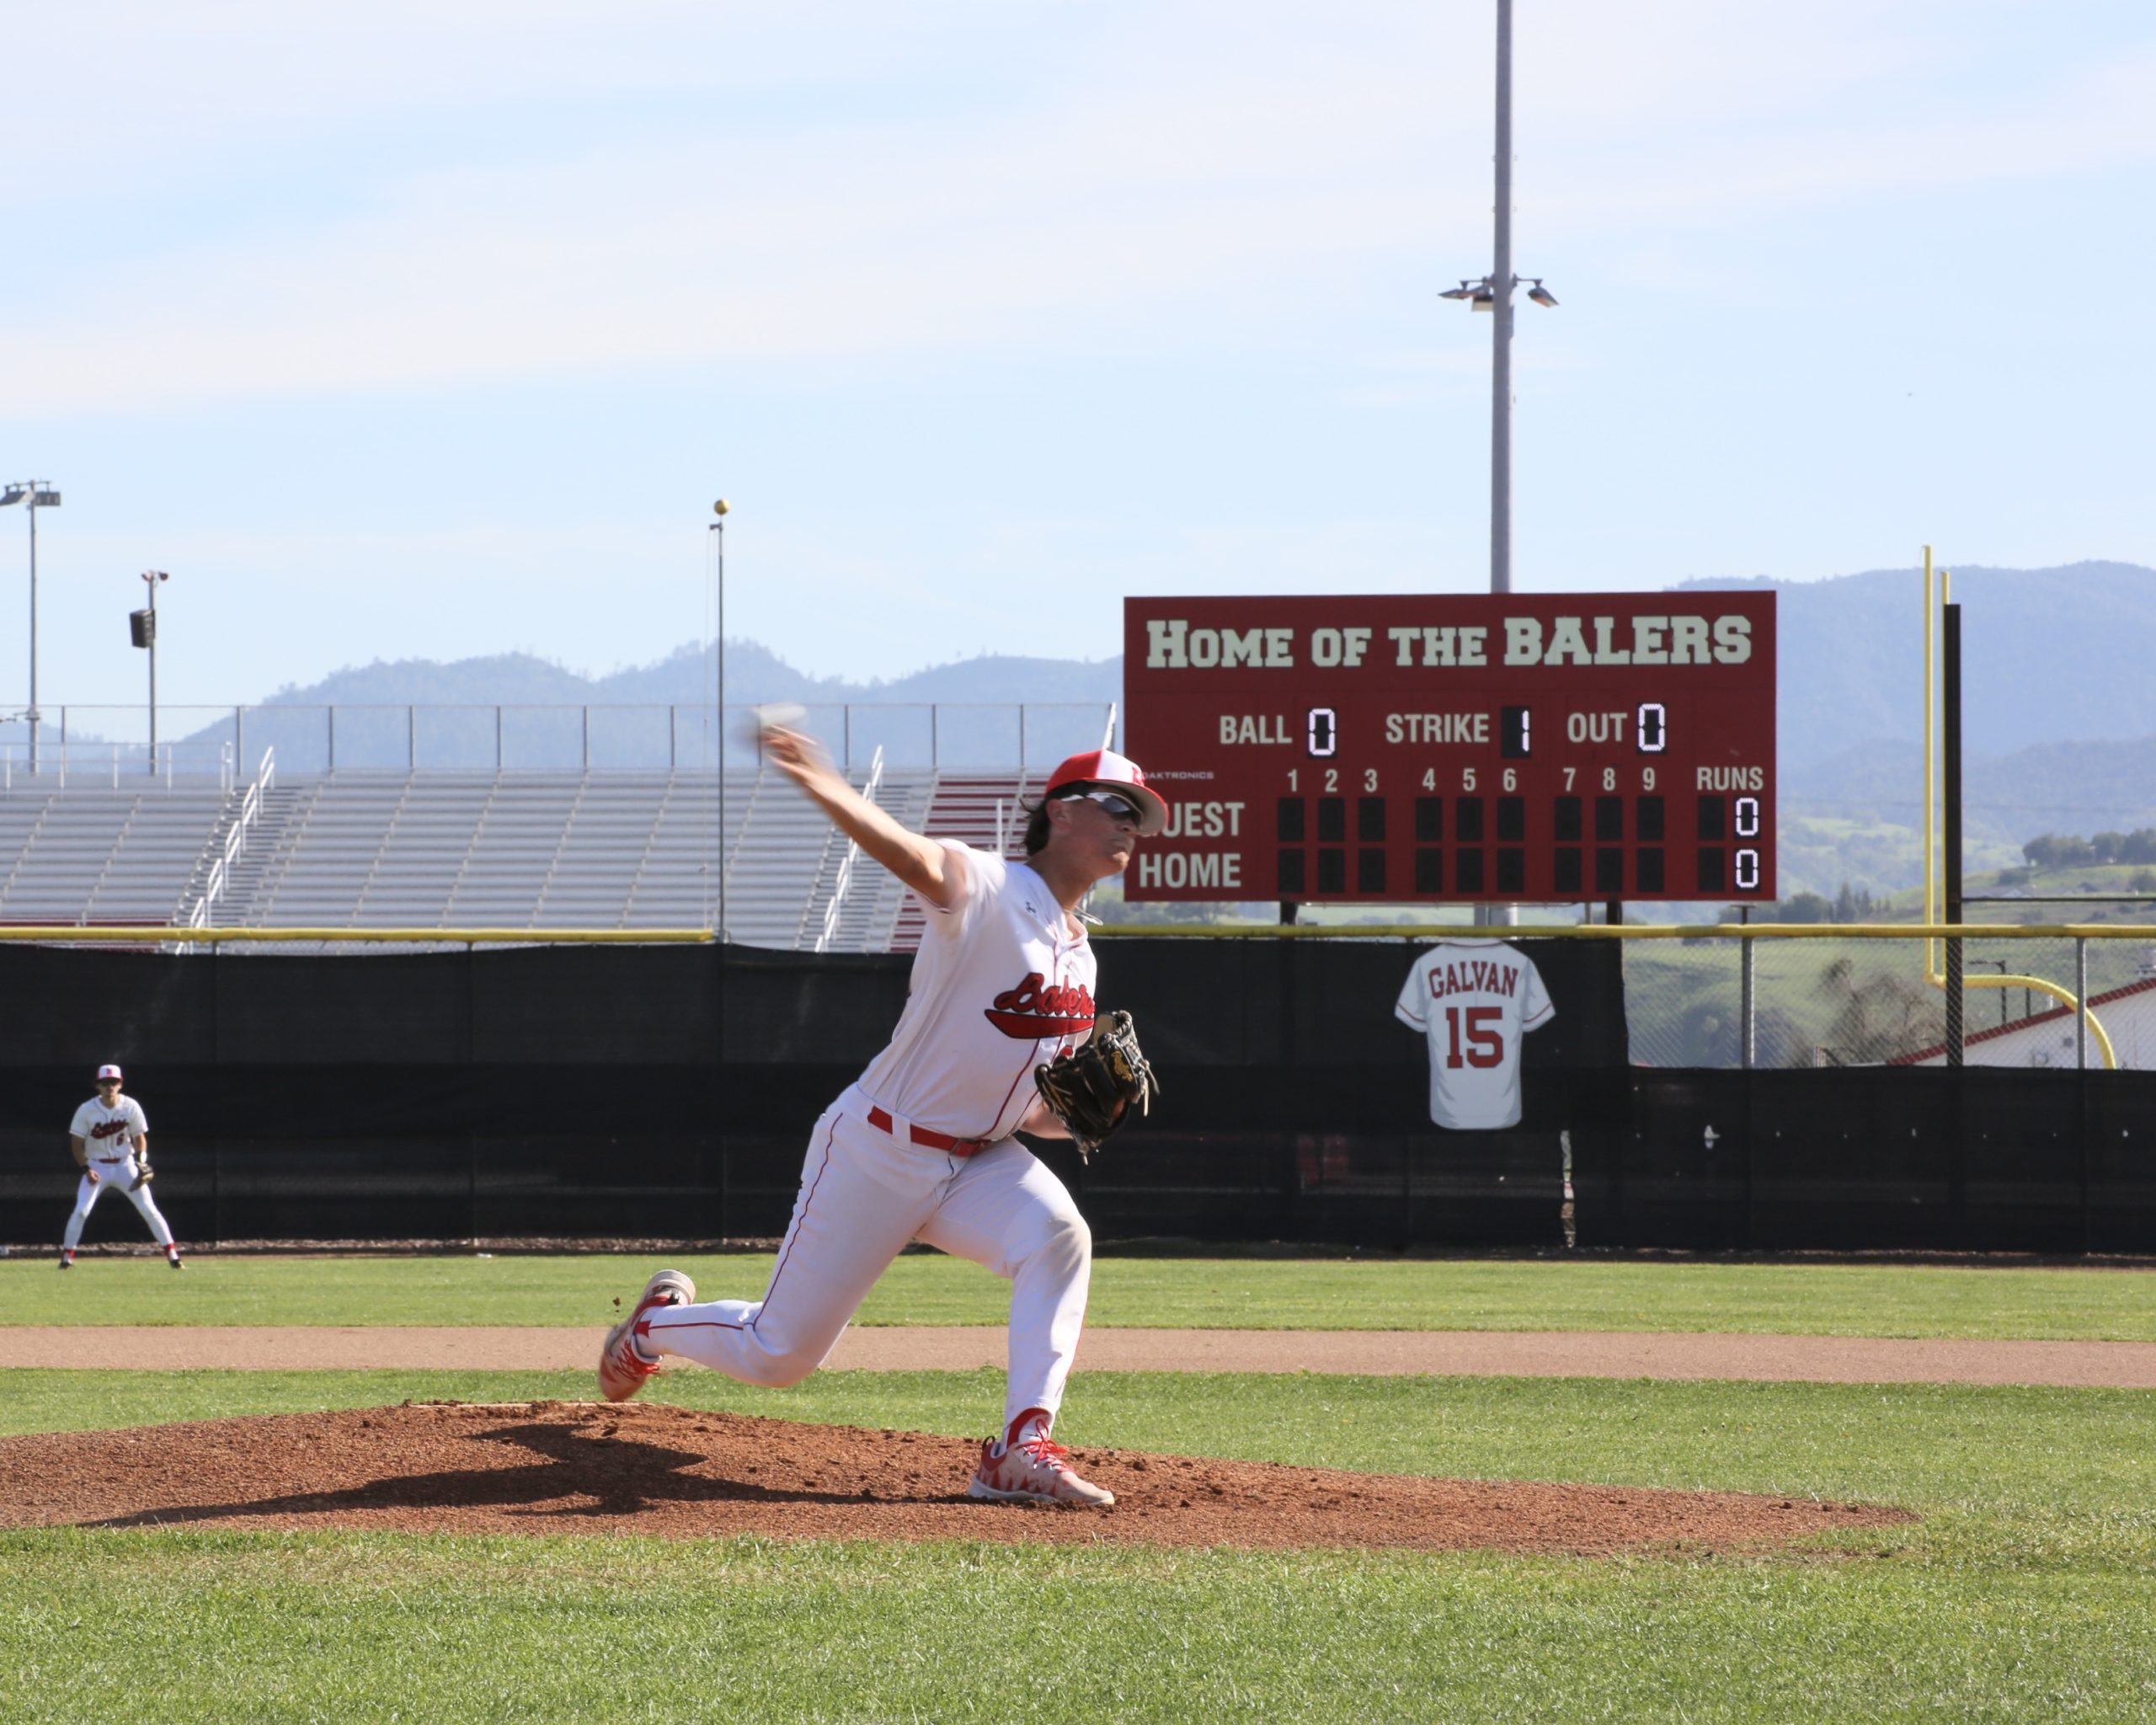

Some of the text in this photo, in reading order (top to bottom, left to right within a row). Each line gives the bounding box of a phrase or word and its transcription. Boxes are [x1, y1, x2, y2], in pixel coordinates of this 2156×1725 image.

[1146, 616, 1752, 668] HOME OF THE BALERS
[1219, 703, 1665, 756] BALL 0 STRIKE 1 OUT 0
[1288, 766, 1764, 792] 1 2 3 4 5 6 7 8 9 RUNS
[1141, 798, 1758, 837] UEST 0
[1139, 849, 1758, 888] HOME 0
[1428, 961, 1518, 999] GALVAN
[1446, 1007, 1504, 1069] 15
